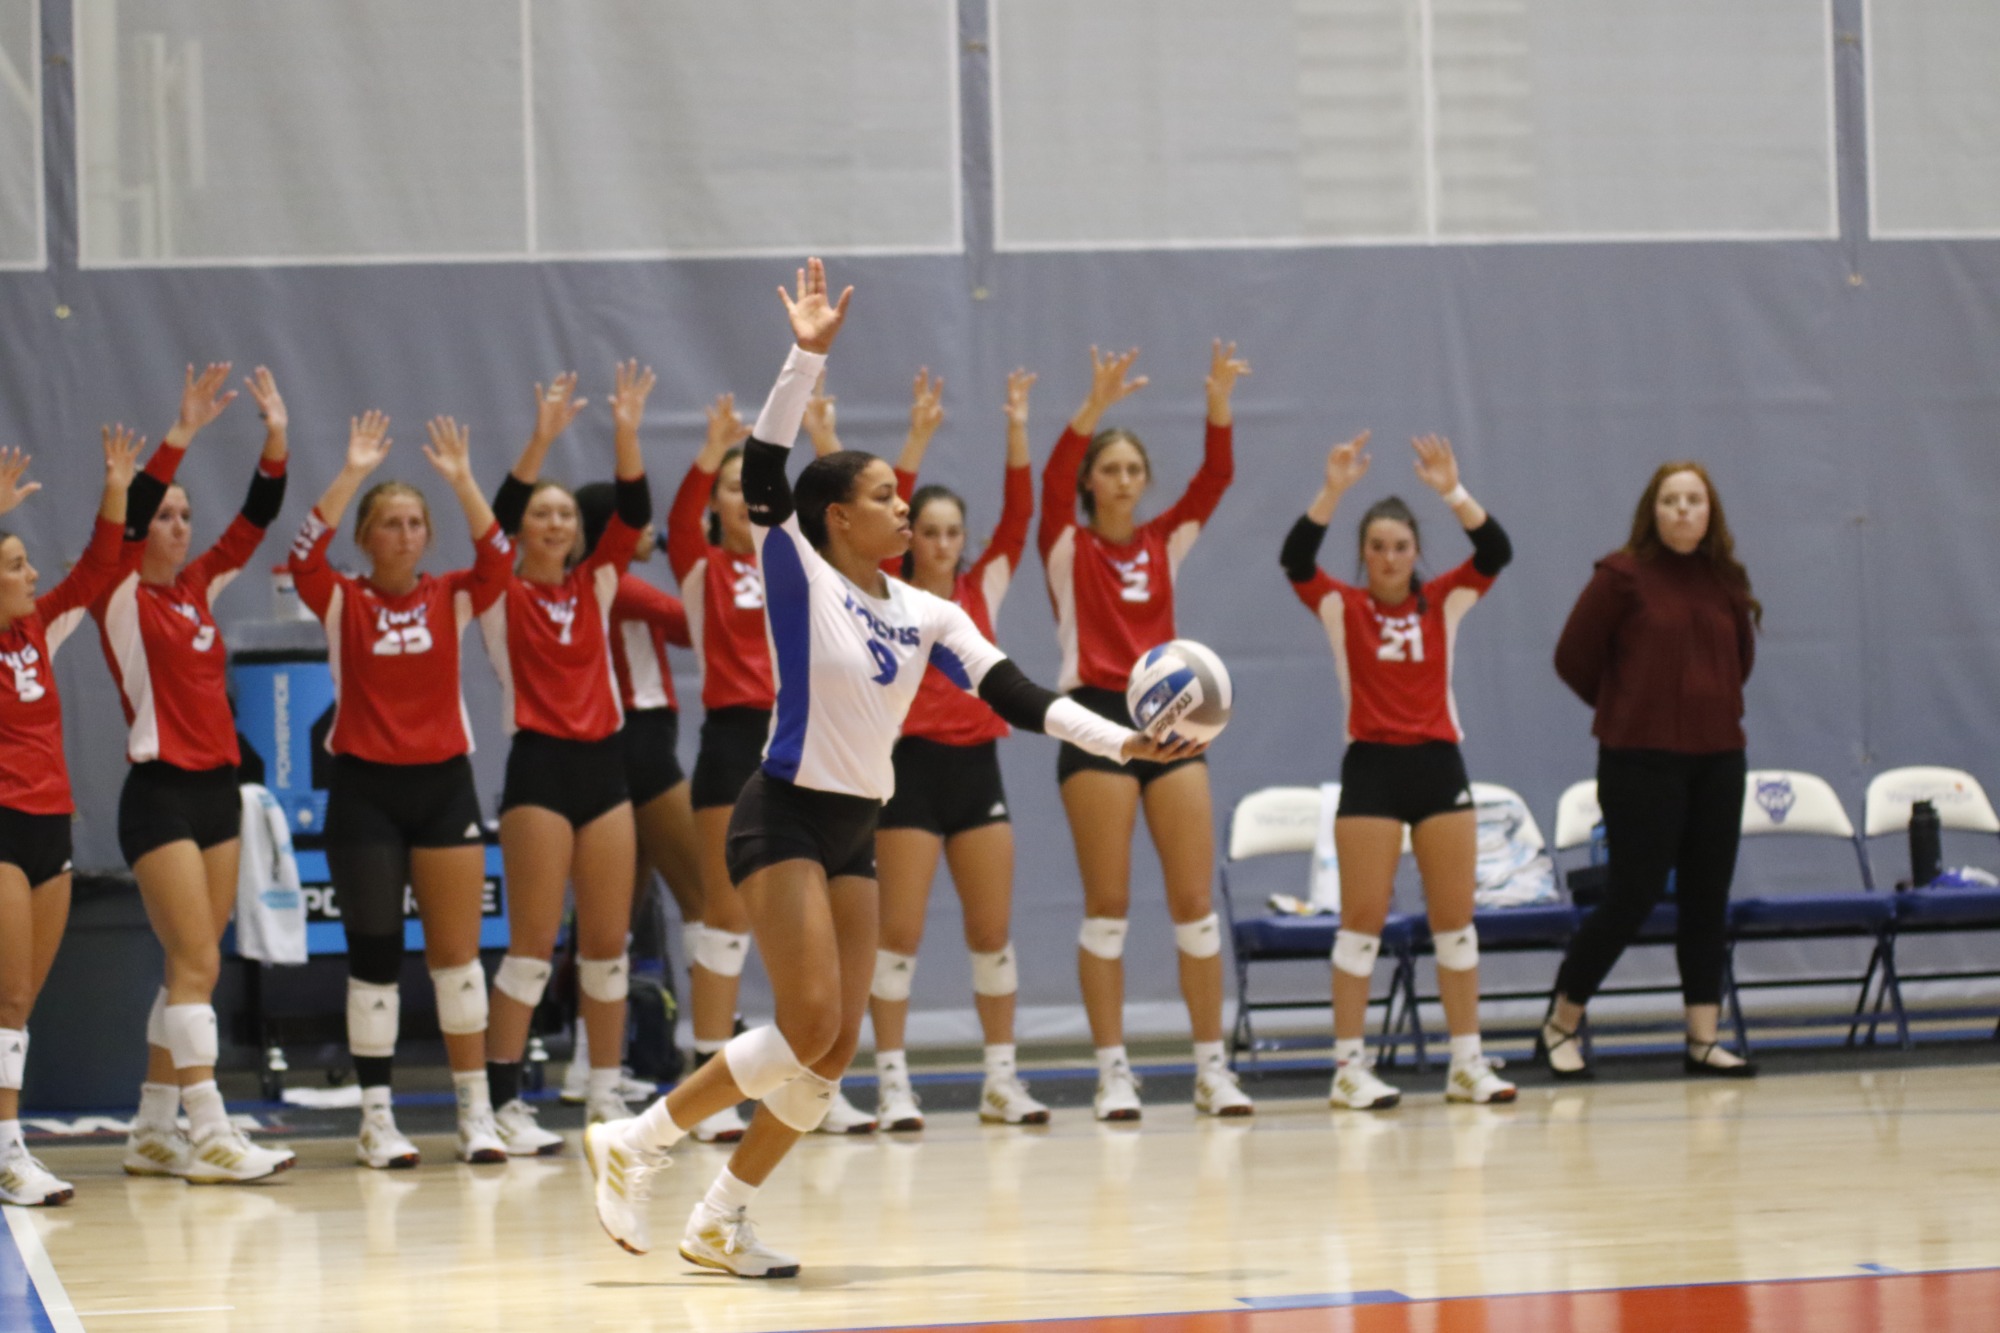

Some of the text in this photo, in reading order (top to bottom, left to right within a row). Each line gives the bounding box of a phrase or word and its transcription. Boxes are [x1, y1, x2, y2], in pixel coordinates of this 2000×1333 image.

[1121, 571, 1150, 601] 2
[1377, 620, 1424, 662] 21
[866, 638, 899, 686] 9
[15, 667, 46, 702] 5
